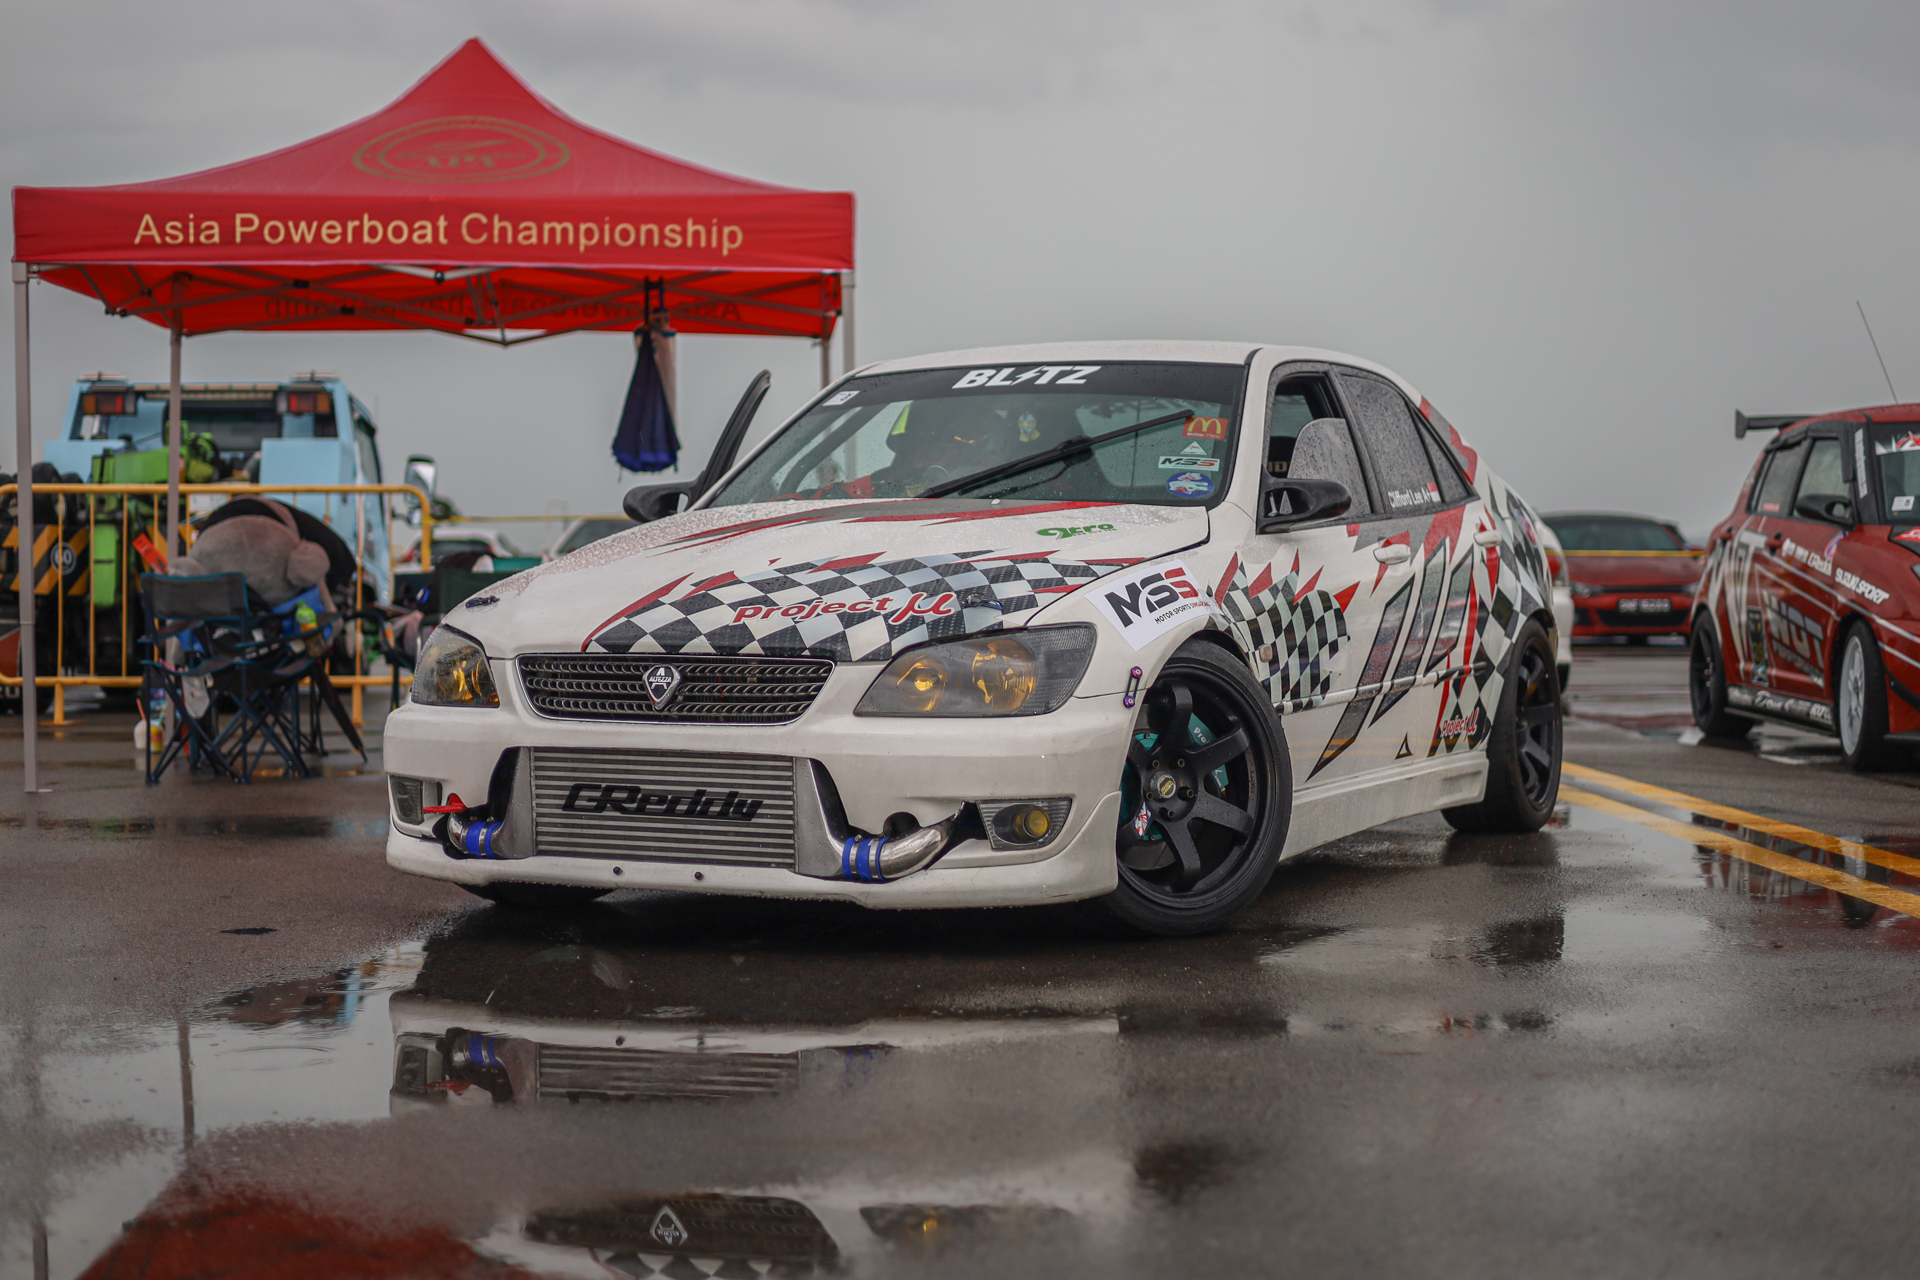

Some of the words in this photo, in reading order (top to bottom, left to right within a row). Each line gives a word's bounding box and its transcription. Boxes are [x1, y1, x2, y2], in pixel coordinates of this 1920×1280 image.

[134, 213, 220, 244] Asia
[235, 212, 448, 244] Powerboat
[461, 212, 743, 256] Championship
[951, 365, 1101, 389] BLITZ
[1160, 458, 1218, 467] MSS
[1104, 567, 1199, 628] MSS
[1855, 579, 1890, 605] SPORT
[729, 596, 896, 625] project
[1154, 609, 1175, 625] MOTOR
[1172, 603, 1192, 615] SPORTS
[648, 675, 672, 683] ALTEZZA
[561, 782, 764, 822] GReddy
